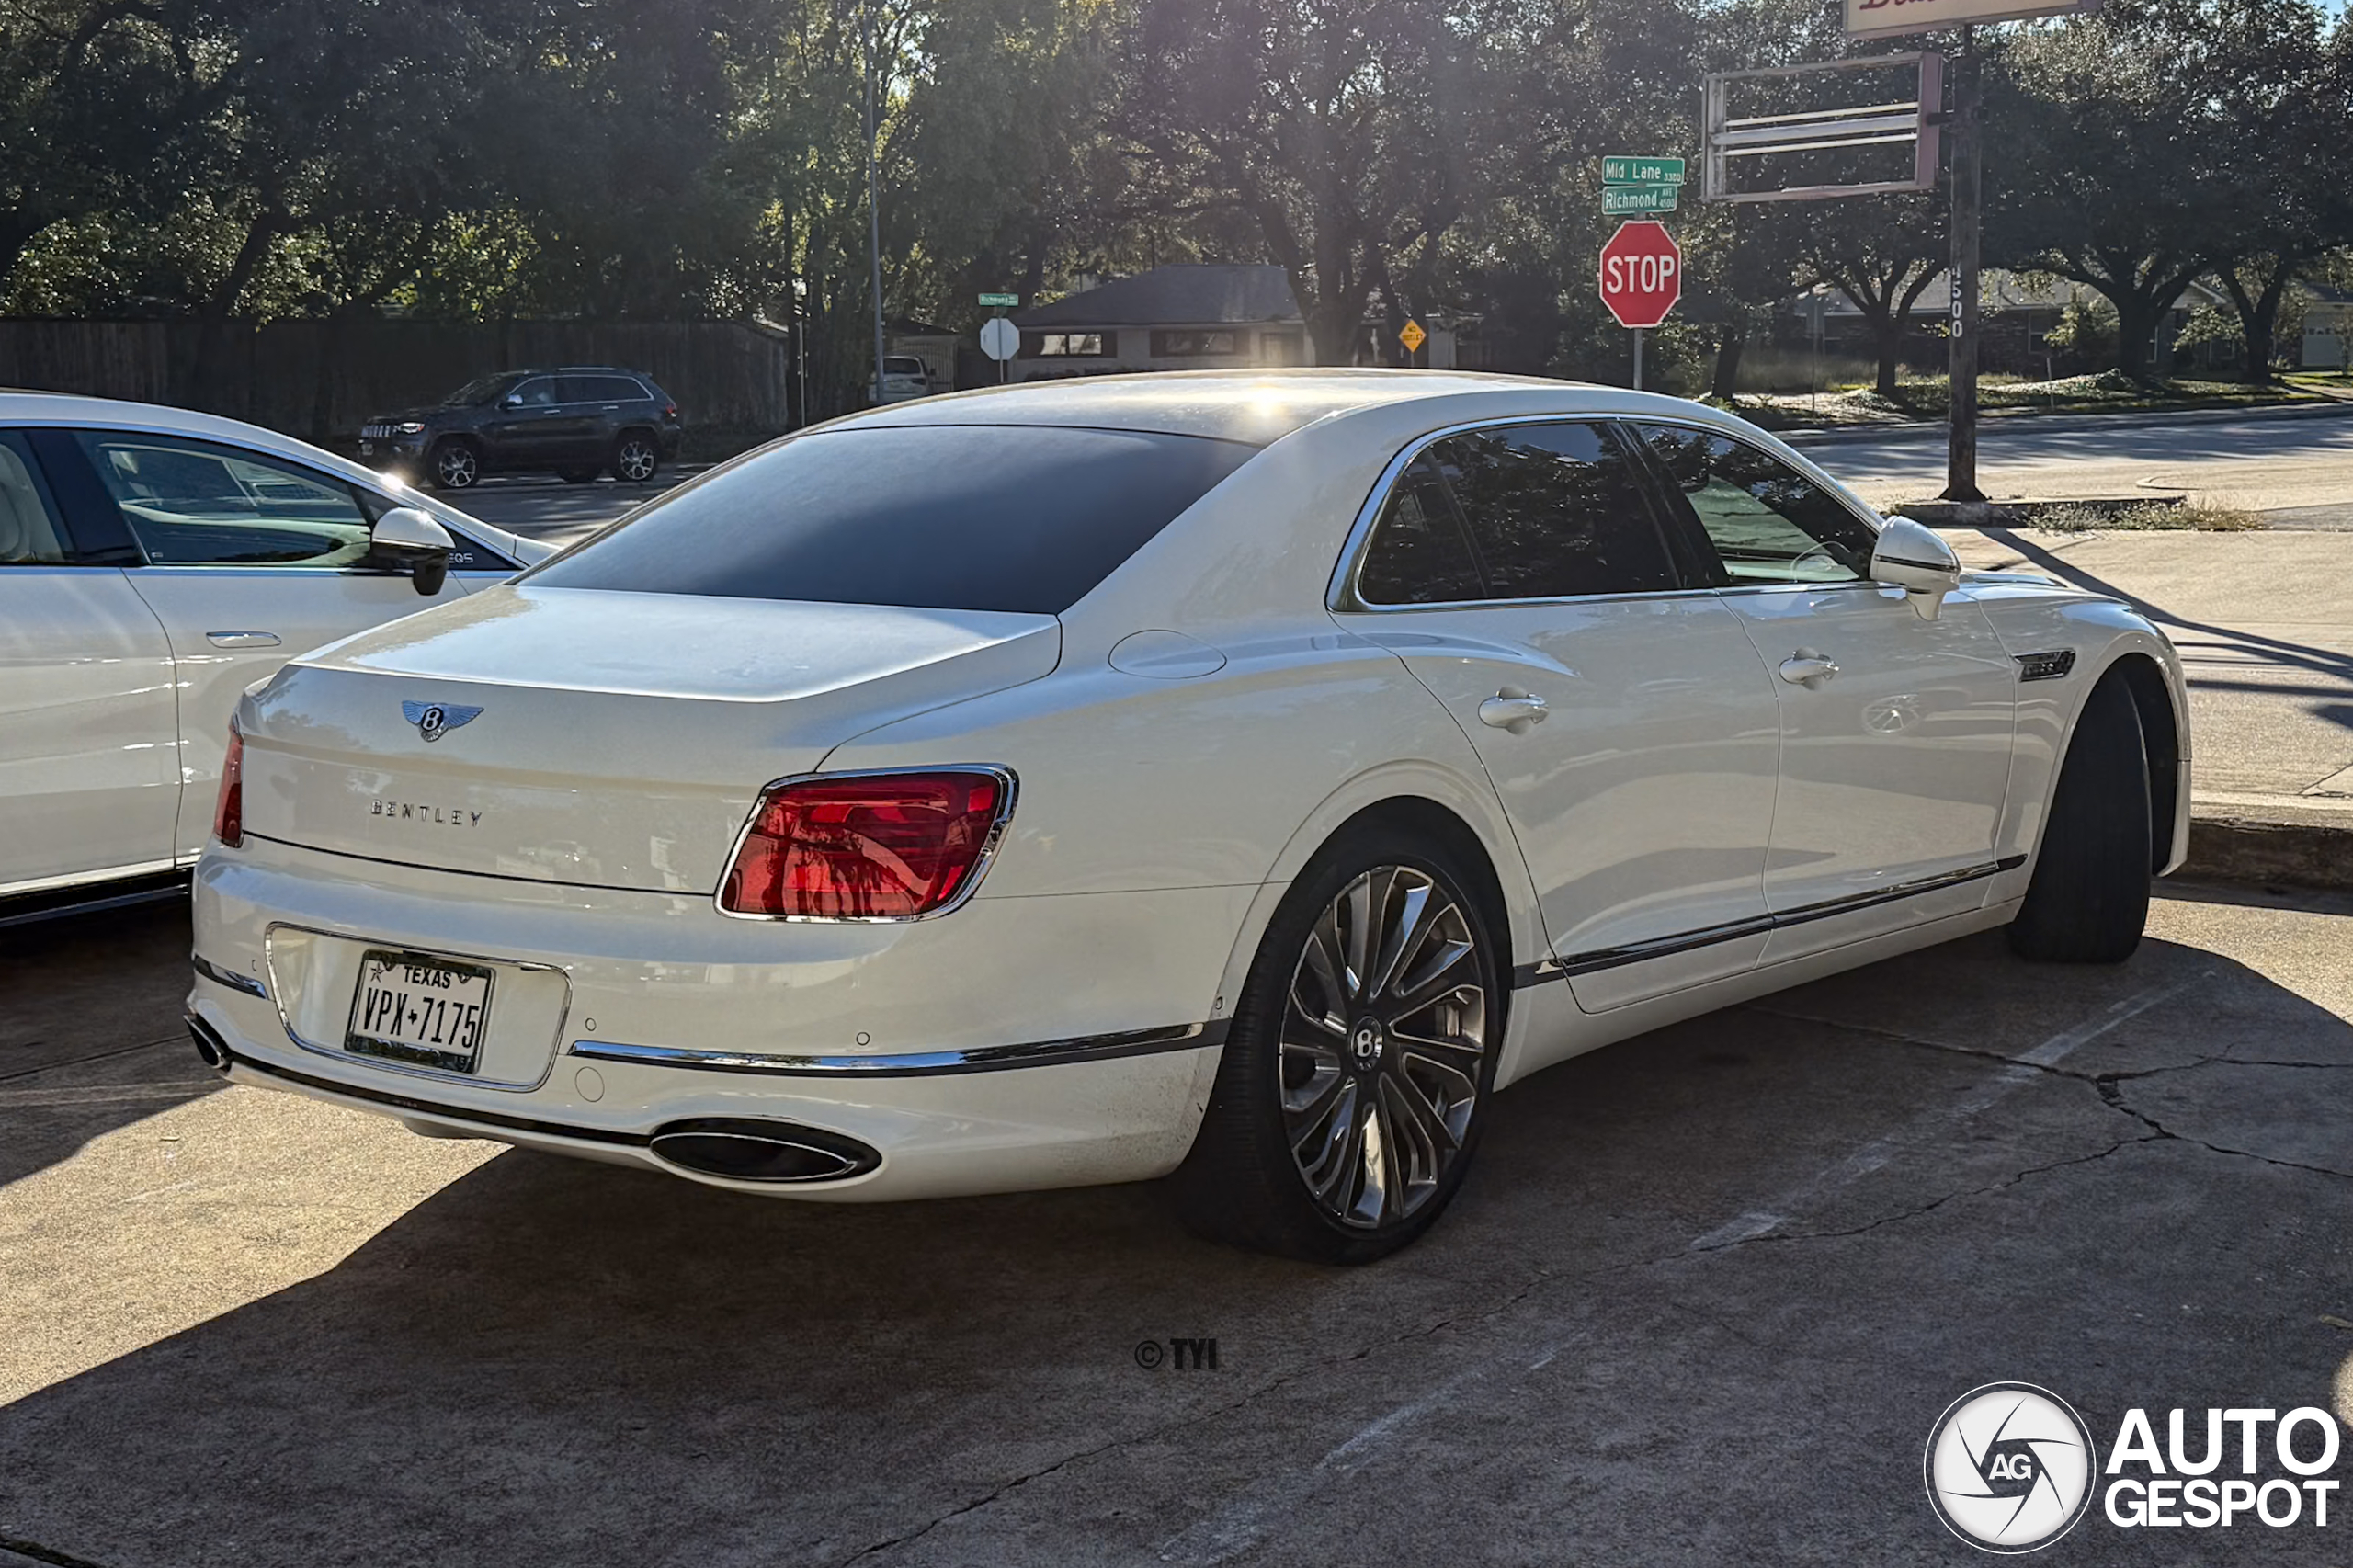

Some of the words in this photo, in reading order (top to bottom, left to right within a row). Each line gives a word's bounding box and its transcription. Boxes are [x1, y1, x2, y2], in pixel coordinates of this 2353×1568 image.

[1605, 162, 1625, 179] Mid
[1632, 162, 1662, 180] Lane
[1605, 190, 1657, 210] Richmond
[1607, 255, 1675, 294] STOP
[449, 552, 473, 564] EQS
[371, 798, 483, 828] BENTLEY
[404, 965, 451, 989] TEXAS
[1356, 1028, 1374, 1058] B
